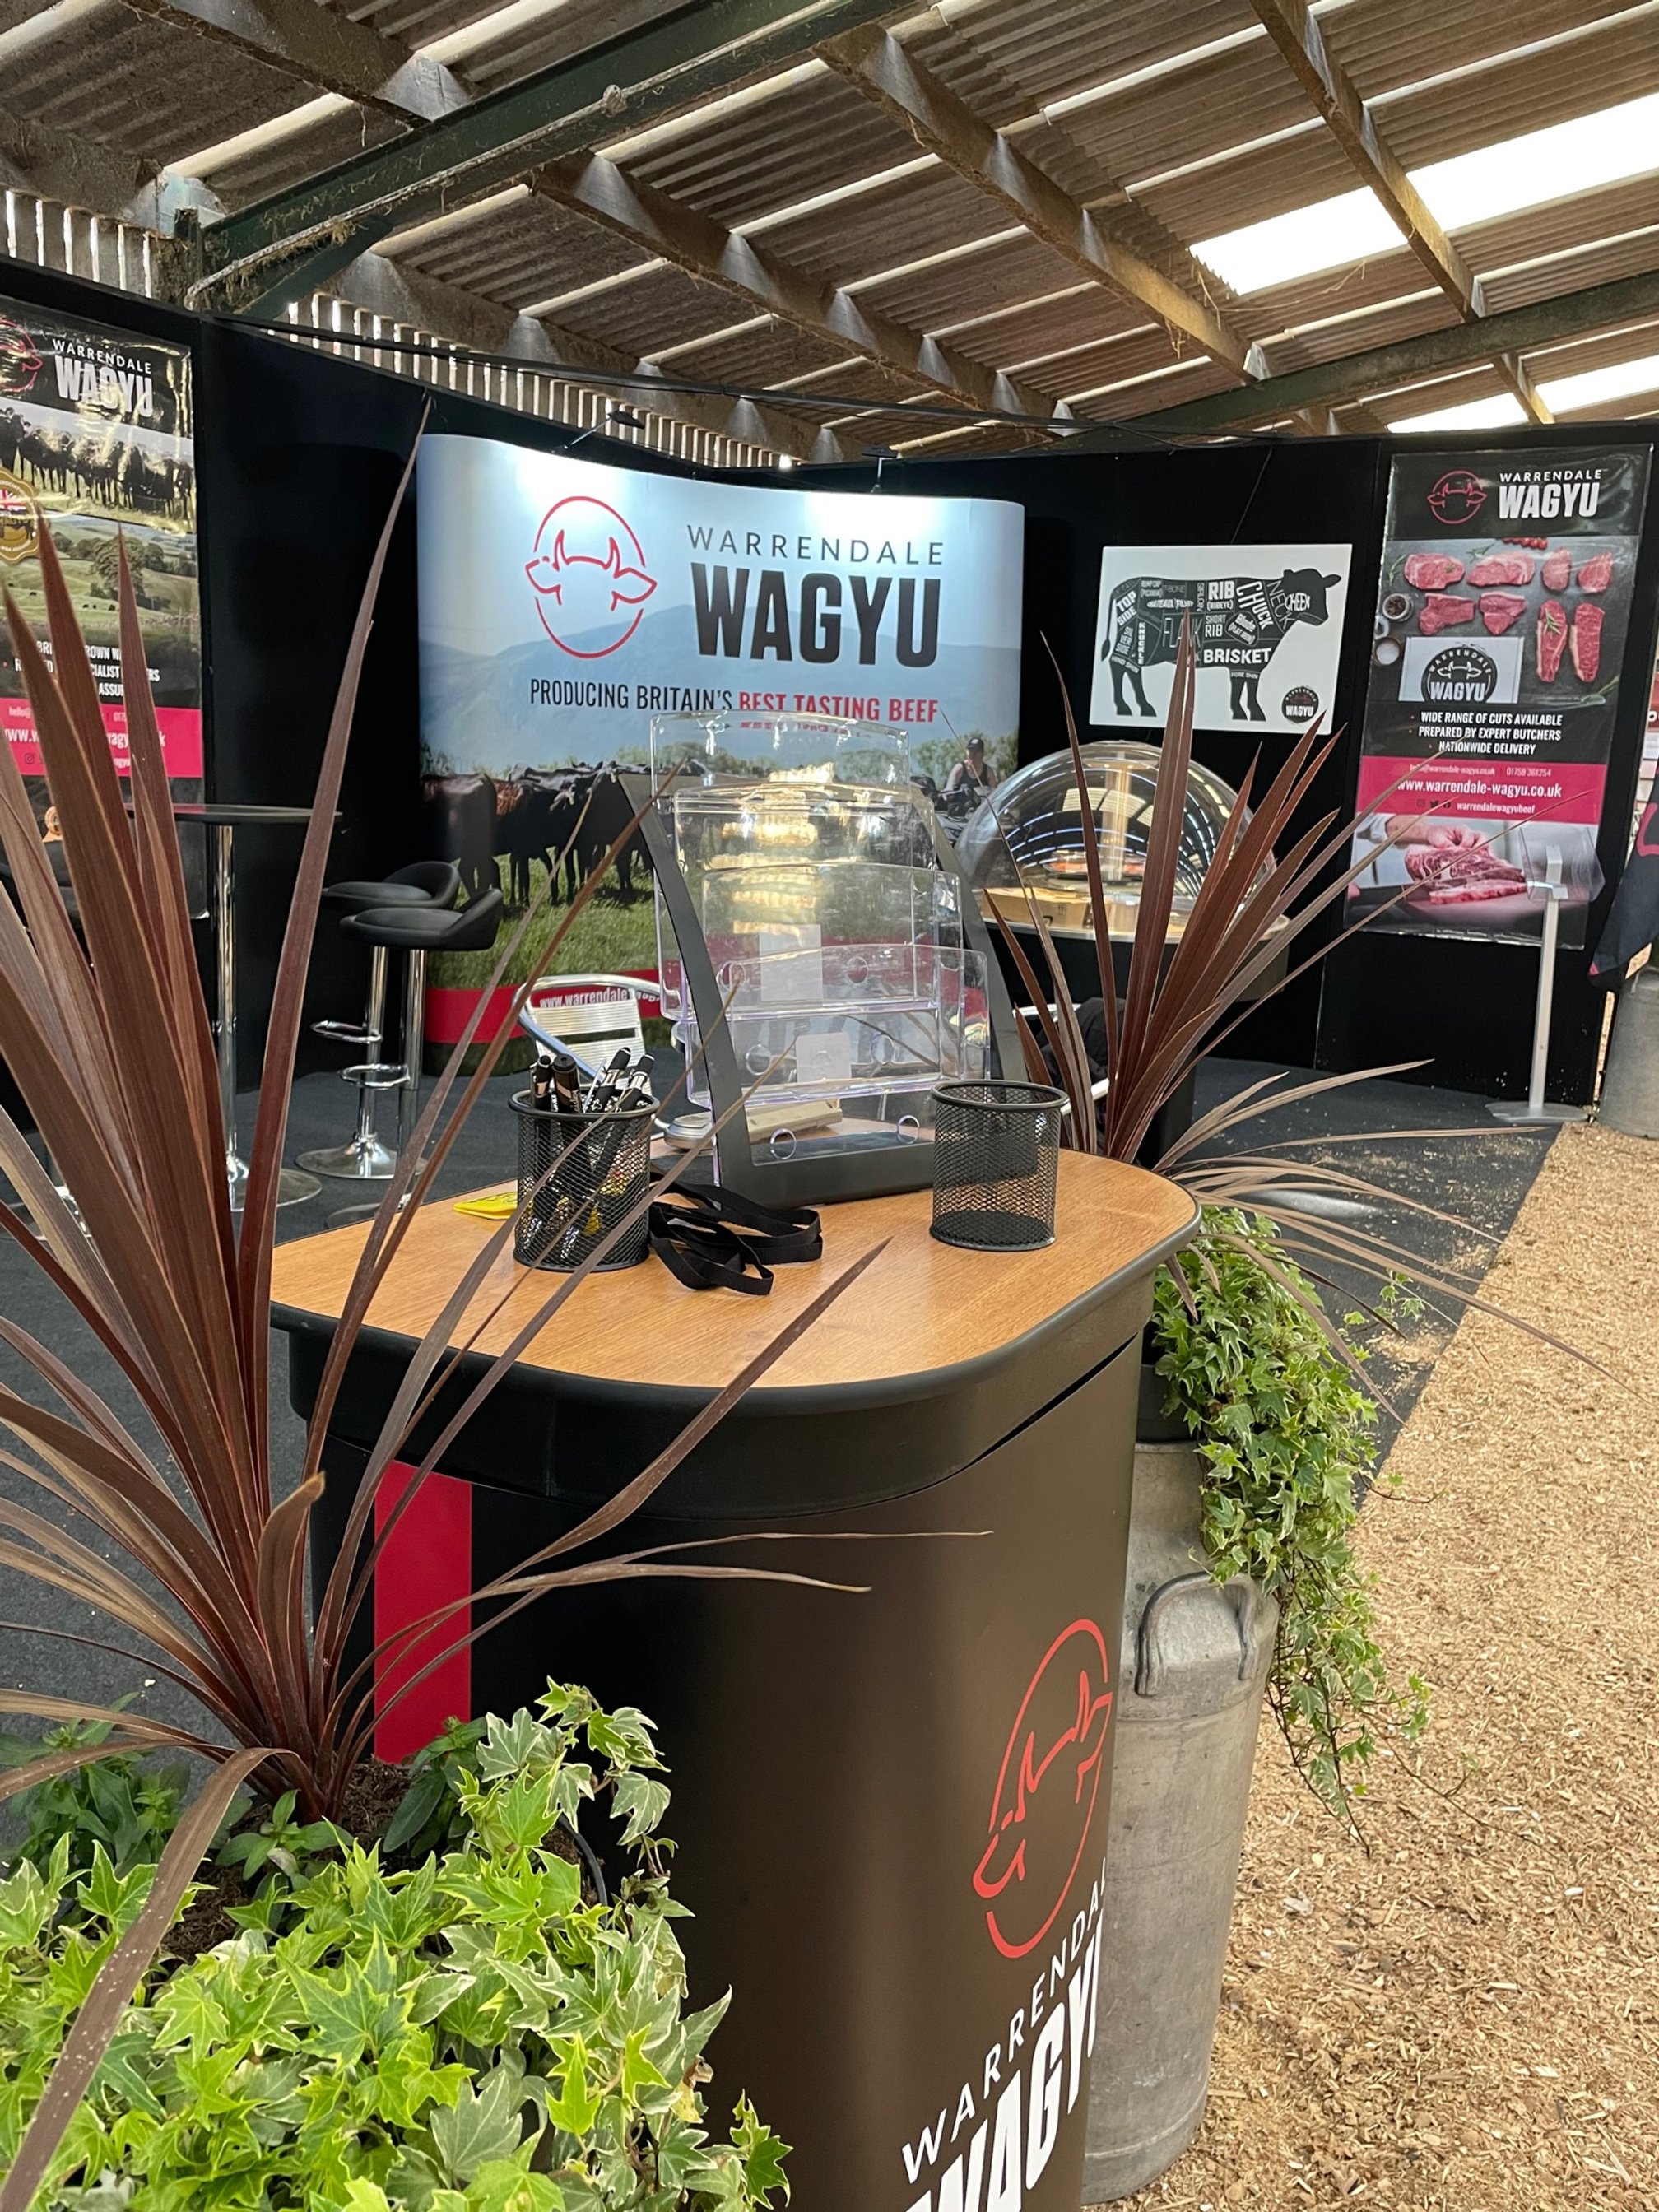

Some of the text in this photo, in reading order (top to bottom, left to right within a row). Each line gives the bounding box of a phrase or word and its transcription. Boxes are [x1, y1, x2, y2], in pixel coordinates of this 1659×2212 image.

[52, 338, 151, 374] WARRENDALE
[55, 356, 153, 418] WAGYU
[1499, 469, 1602, 483] WARRENDALE
[1499, 482, 1601, 519] WAGYU
[686, 524, 944, 565] WARRENDALE
[1208, 580, 1234, 600] RIB
[1116, 591, 1136, 612] TOP
[1236, 580, 1274, 630] CHUCK
[1267, 579, 1295, 629] NECK
[690, 562, 941, 667] WAGYU
[1118, 606, 1136, 625] SIDE
[1163, 617, 1202, 648] FLK
[1205, 624, 1223, 637] RIB
[1203, 648, 1271, 664] BRISKET
[530, 678, 939, 723] PRODUCING BRITAIN'S BEST TASTING BEEF
[1430, 681, 1486, 702] WAGYU
[1285, 705, 1313, 717] WAGYU
[1421, 711, 1564, 727] WIDE RANGE OF CUTS AVAILABLE
[1418, 726, 1562, 741] PREPARED BY EXPERT BUTCHERS
[1438, 741, 1536, 755] NATIONWIDE DELIVERY
[1397, 779, 1563, 799] www.warrendale-wagyu.co.uk
[1457, 802, 1536, 815] warrendalewagyubeef
[905, 1907, 1104, 2212] AGY
